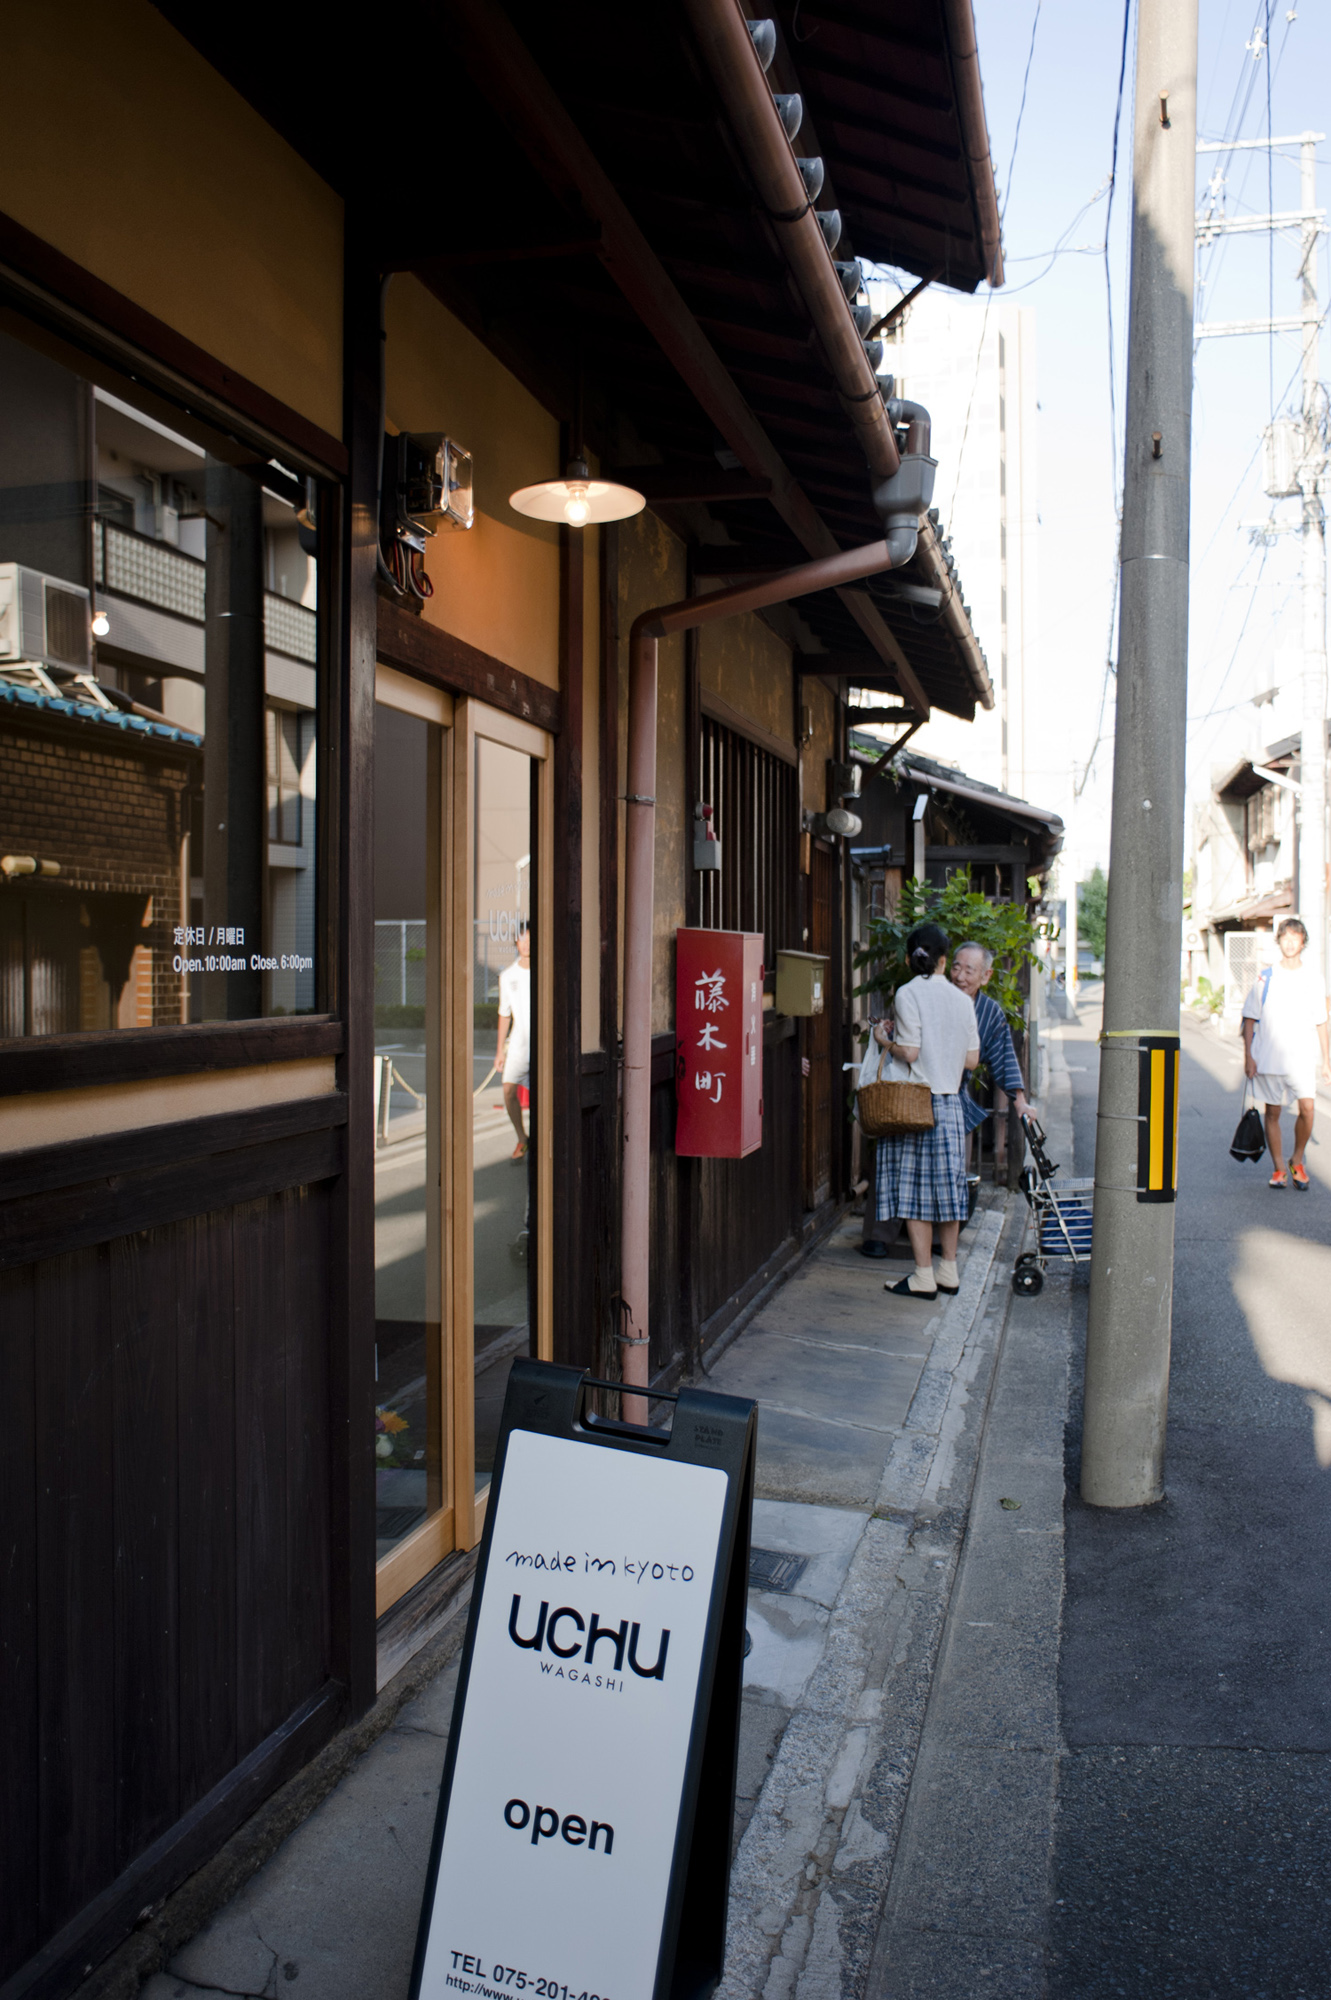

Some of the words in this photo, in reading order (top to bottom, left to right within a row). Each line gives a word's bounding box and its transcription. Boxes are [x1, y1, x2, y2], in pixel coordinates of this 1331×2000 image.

[173, 926, 205, 946] 定休日
[280, 954, 313, 973] 6:00pm
[694, 968, 730, 1103] 藤木町
[505, 1550, 577, 1573] made
[584, 1552, 616, 1576] in
[623, 1556, 695, 1585] kyoto
[540, 1660, 624, 1693] WAGASHI
[503, 1798, 615, 1856] open
[450, 1950, 487, 1978] TEL
[493, 1964, 611, 2000] 075-201-4
